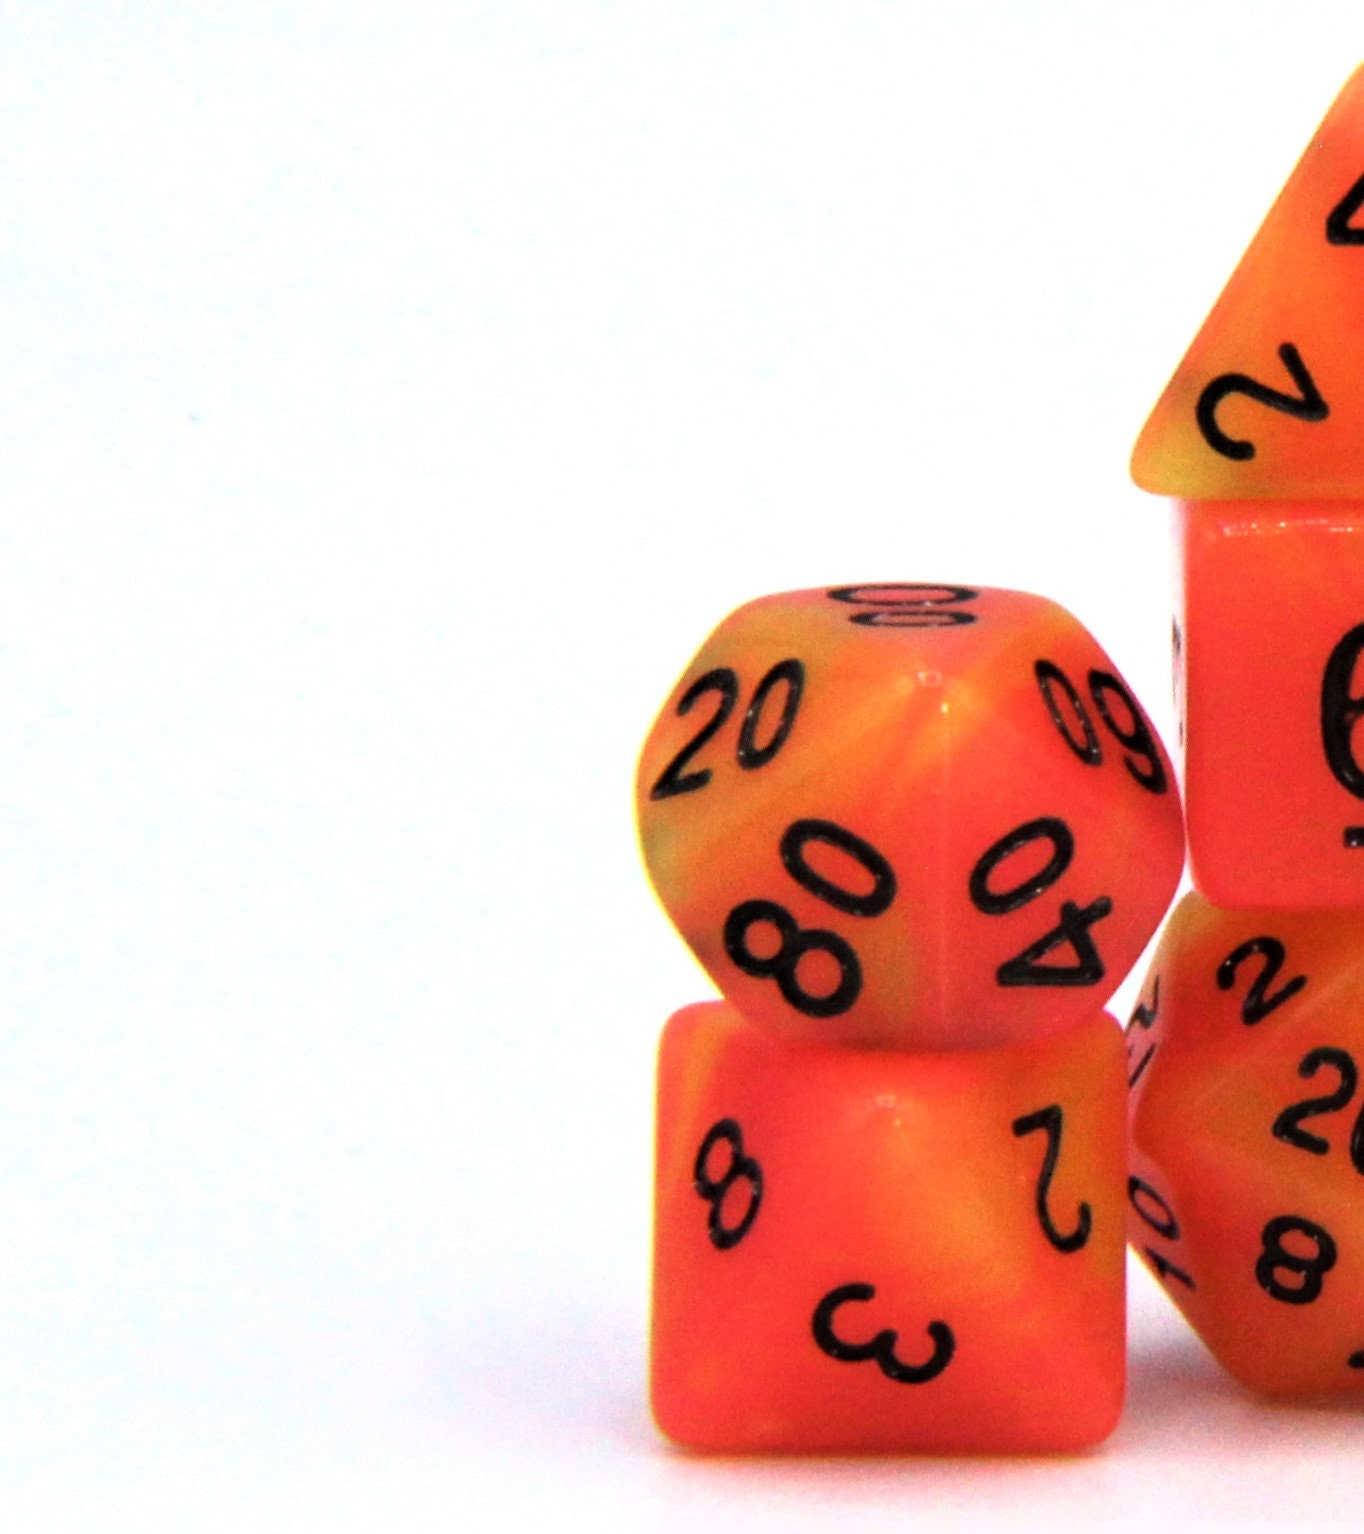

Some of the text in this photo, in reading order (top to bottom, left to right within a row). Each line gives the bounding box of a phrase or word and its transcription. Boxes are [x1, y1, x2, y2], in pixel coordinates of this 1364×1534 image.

[1195, 342, 1330, 462] 2
[651, 658, 806, 801] 20
[722, 818, 898, 1019] 80
[968, 817, 1113, 988] 40
[1215, 935, 1308, 1027] 2
[694, 1118, 764, 1251] 8
[1012, 1104, 1093, 1254] 2
[1254, 1214, 1339, 1307] 8
[811, 1282, 956, 1385] 3
